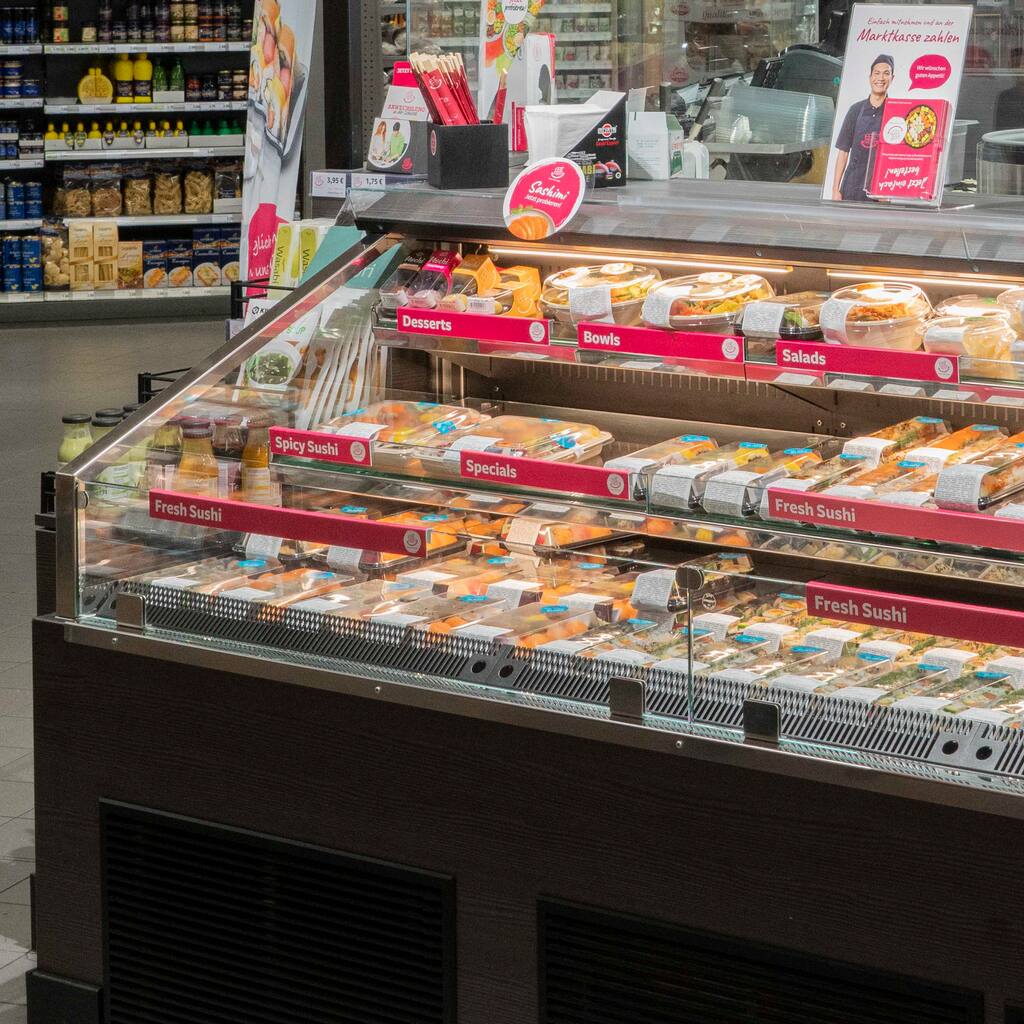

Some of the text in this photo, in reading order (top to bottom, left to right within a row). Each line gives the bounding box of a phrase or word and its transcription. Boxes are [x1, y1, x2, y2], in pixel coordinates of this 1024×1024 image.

[867, 17, 890, 26] Einfach
[891, 17, 922, 27] mitnehmen
[923, 18, 935, 27] und
[944, 19, 955, 27] der
[856, 28, 961, 44] Marktkasse zahlen
[528, 180, 571, 200] Sashimi
[402, 314, 452, 332] Desserts
[583, 329, 621, 347] Bowls
[782, 348, 827, 366] Salads
[275, 435, 339, 456] Spicy Sushi
[465, 459, 518, 479] Specials
[154, 499, 222, 523] Fresh Sushi
[775, 498, 857, 523] Fresh Sushi
[814, 594, 908, 624] Fresh Sushi
